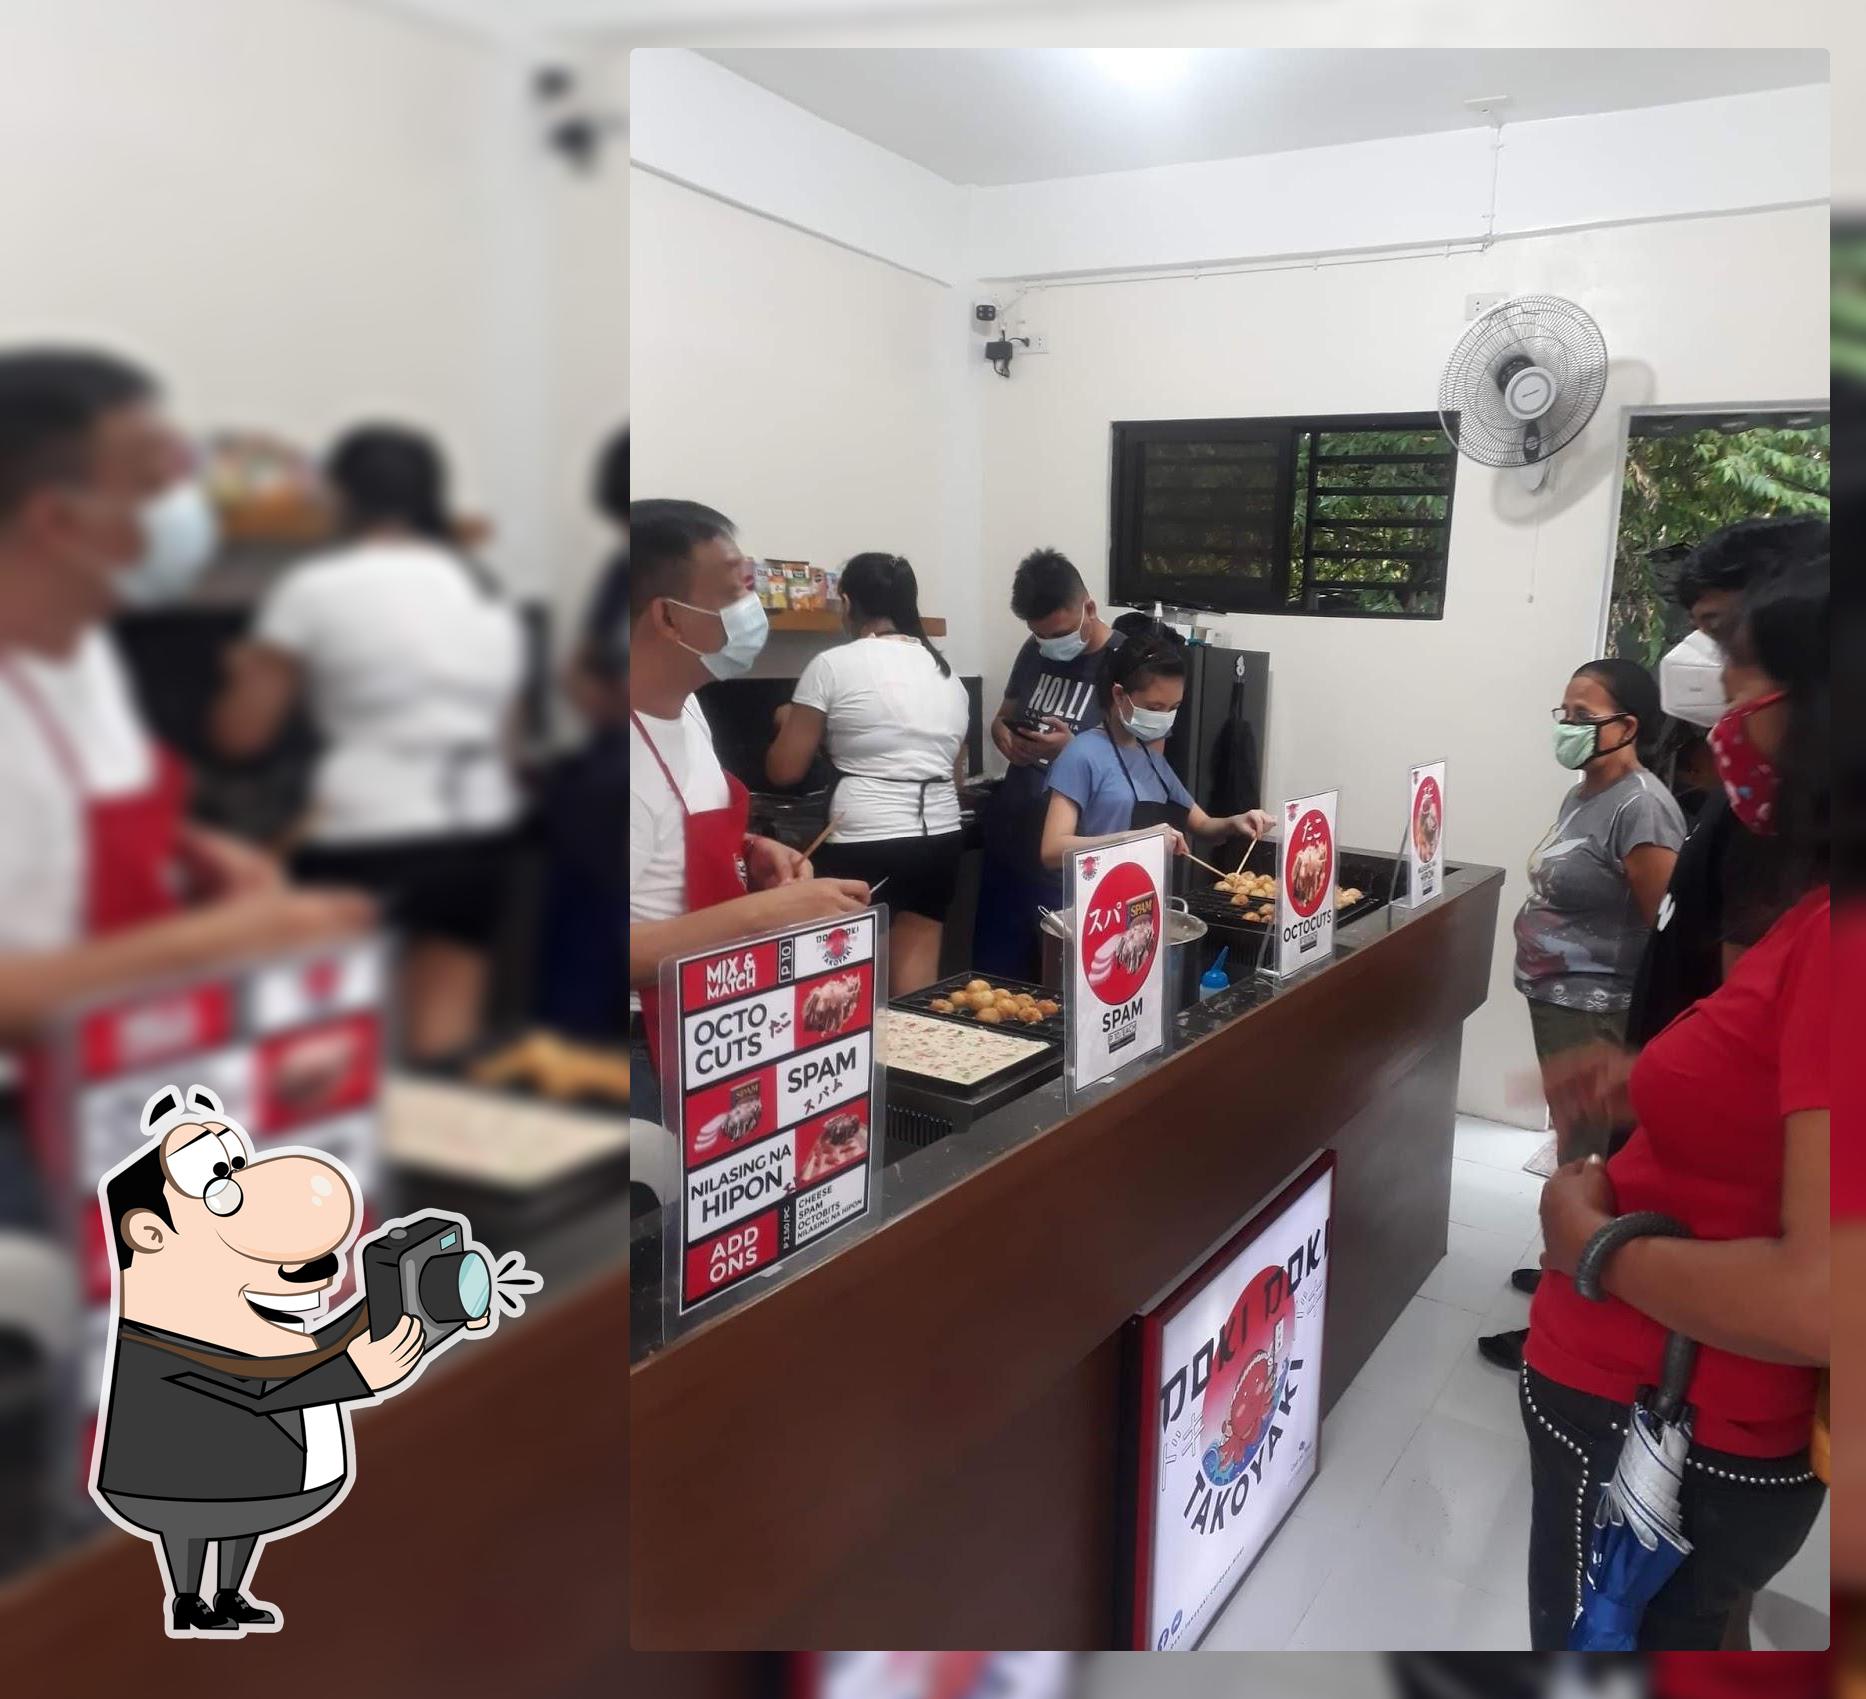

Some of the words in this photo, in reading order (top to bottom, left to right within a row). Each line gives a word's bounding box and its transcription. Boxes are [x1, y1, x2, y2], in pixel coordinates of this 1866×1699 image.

[1130, 899, 1153, 917] SPAM
[1283, 909, 1331, 942] OCTOCUTS
[706, 956, 739, 983] MIX
[744, 952, 756, 971] &
[781, 966, 791, 976] P
[782, 945, 791, 962] 10
[706, 969, 756, 1001] MATCH
[694, 1003, 767, 1046] OCTO
[1102, 997, 1142, 1033] SPAM
[695, 1032, 763, 1075] CUTS
[787, 1046, 856, 1093] SPAM
[691, 1155, 766, 1200] NILASING
[769, 1143, 792, 1163] NA
[702, 1165, 783, 1223] HIPON
[798, 1185, 833, 1208] CHEESE
[798, 1200, 823, 1220] SPAM
[797, 1201, 841, 1231] OCTOBITS
[797, 1218, 830, 1239] NILASING
[841, 1197, 863, 1214] HIPON
[710, 1226, 759, 1264] ADD
[709, 1246, 758, 1283] ONS
[1161, 1303, 1248, 1433] DOKI
[1264, 1218, 1330, 1321] DOKI
[1183, 1359, 1304, 1535] TAKOYAKI
